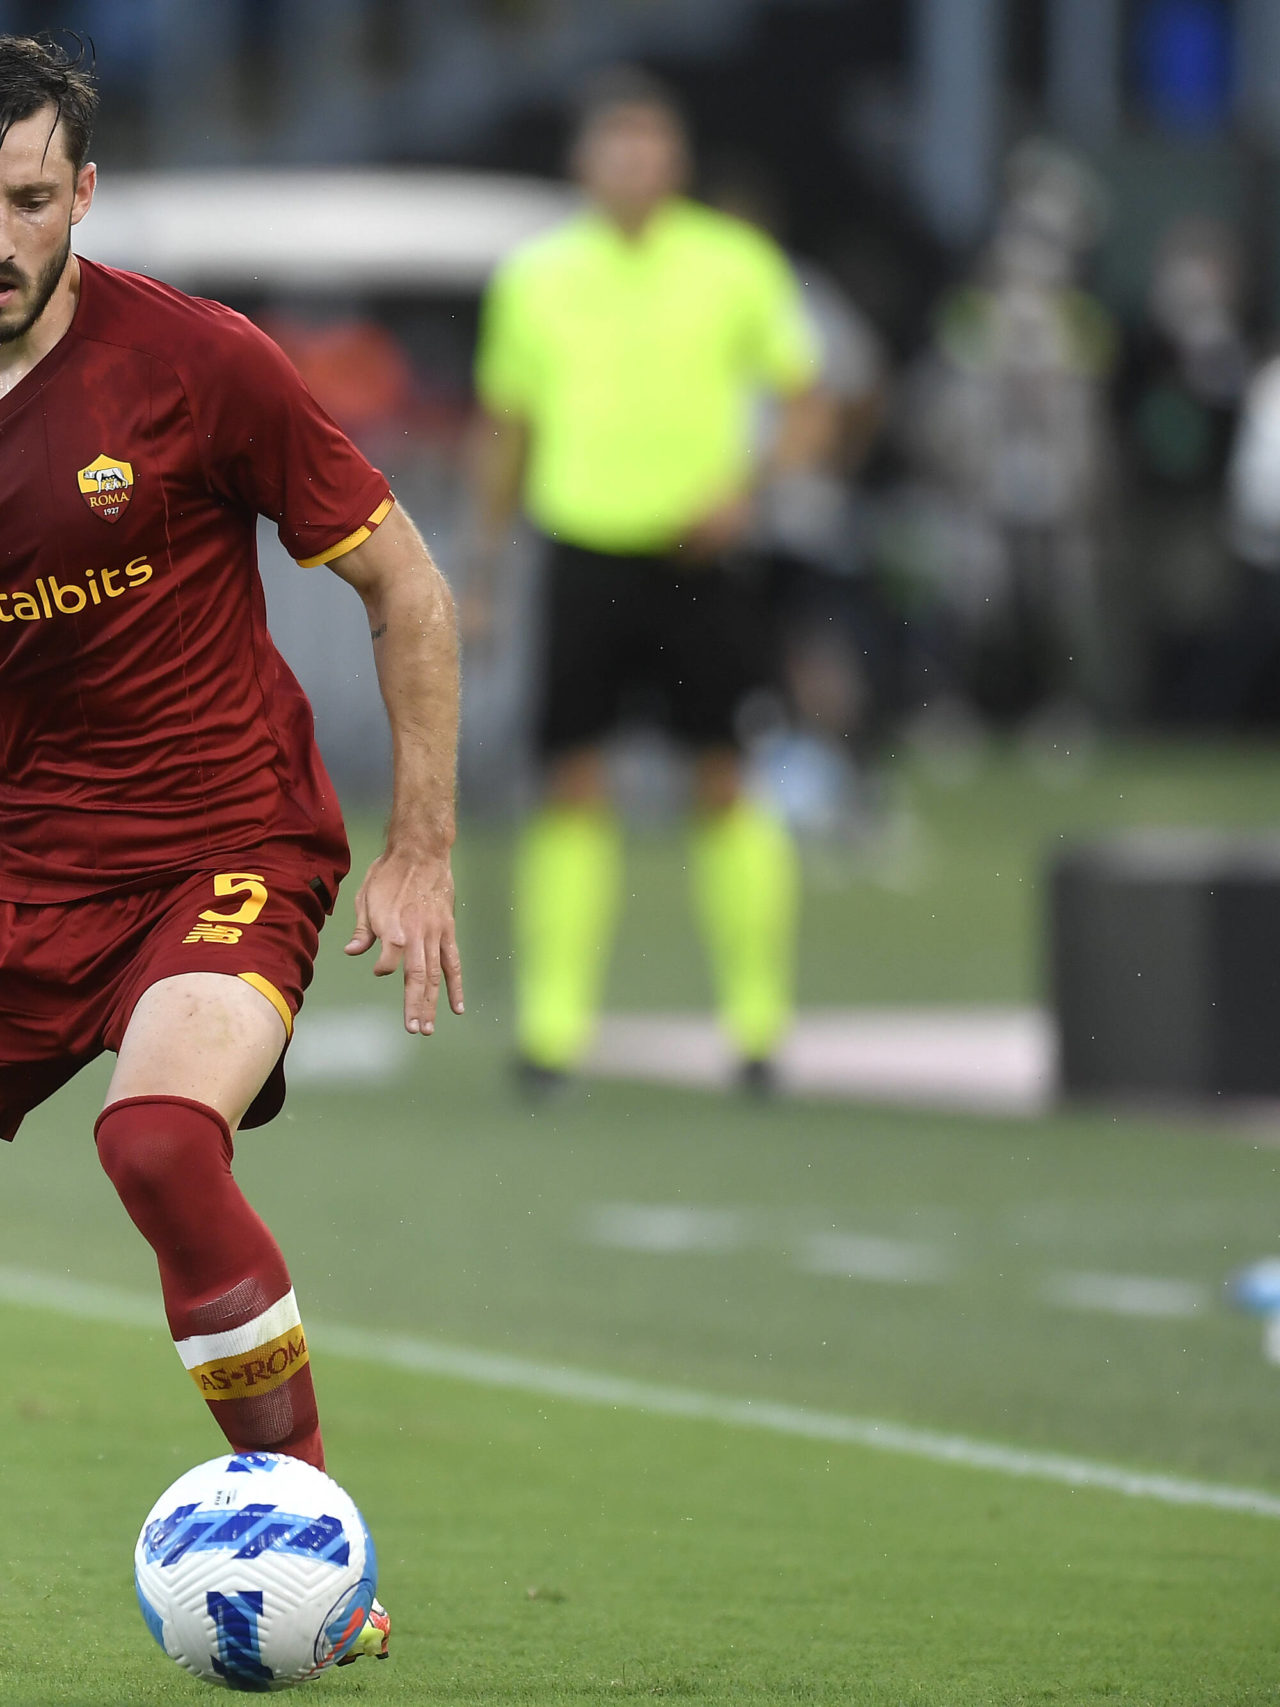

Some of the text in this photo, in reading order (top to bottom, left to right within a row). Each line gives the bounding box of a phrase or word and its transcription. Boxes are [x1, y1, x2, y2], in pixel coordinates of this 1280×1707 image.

[89, 491, 130, 508] ROMA
[103, 506, 120, 516] 1927
[198, 873, 269, 925] 5
